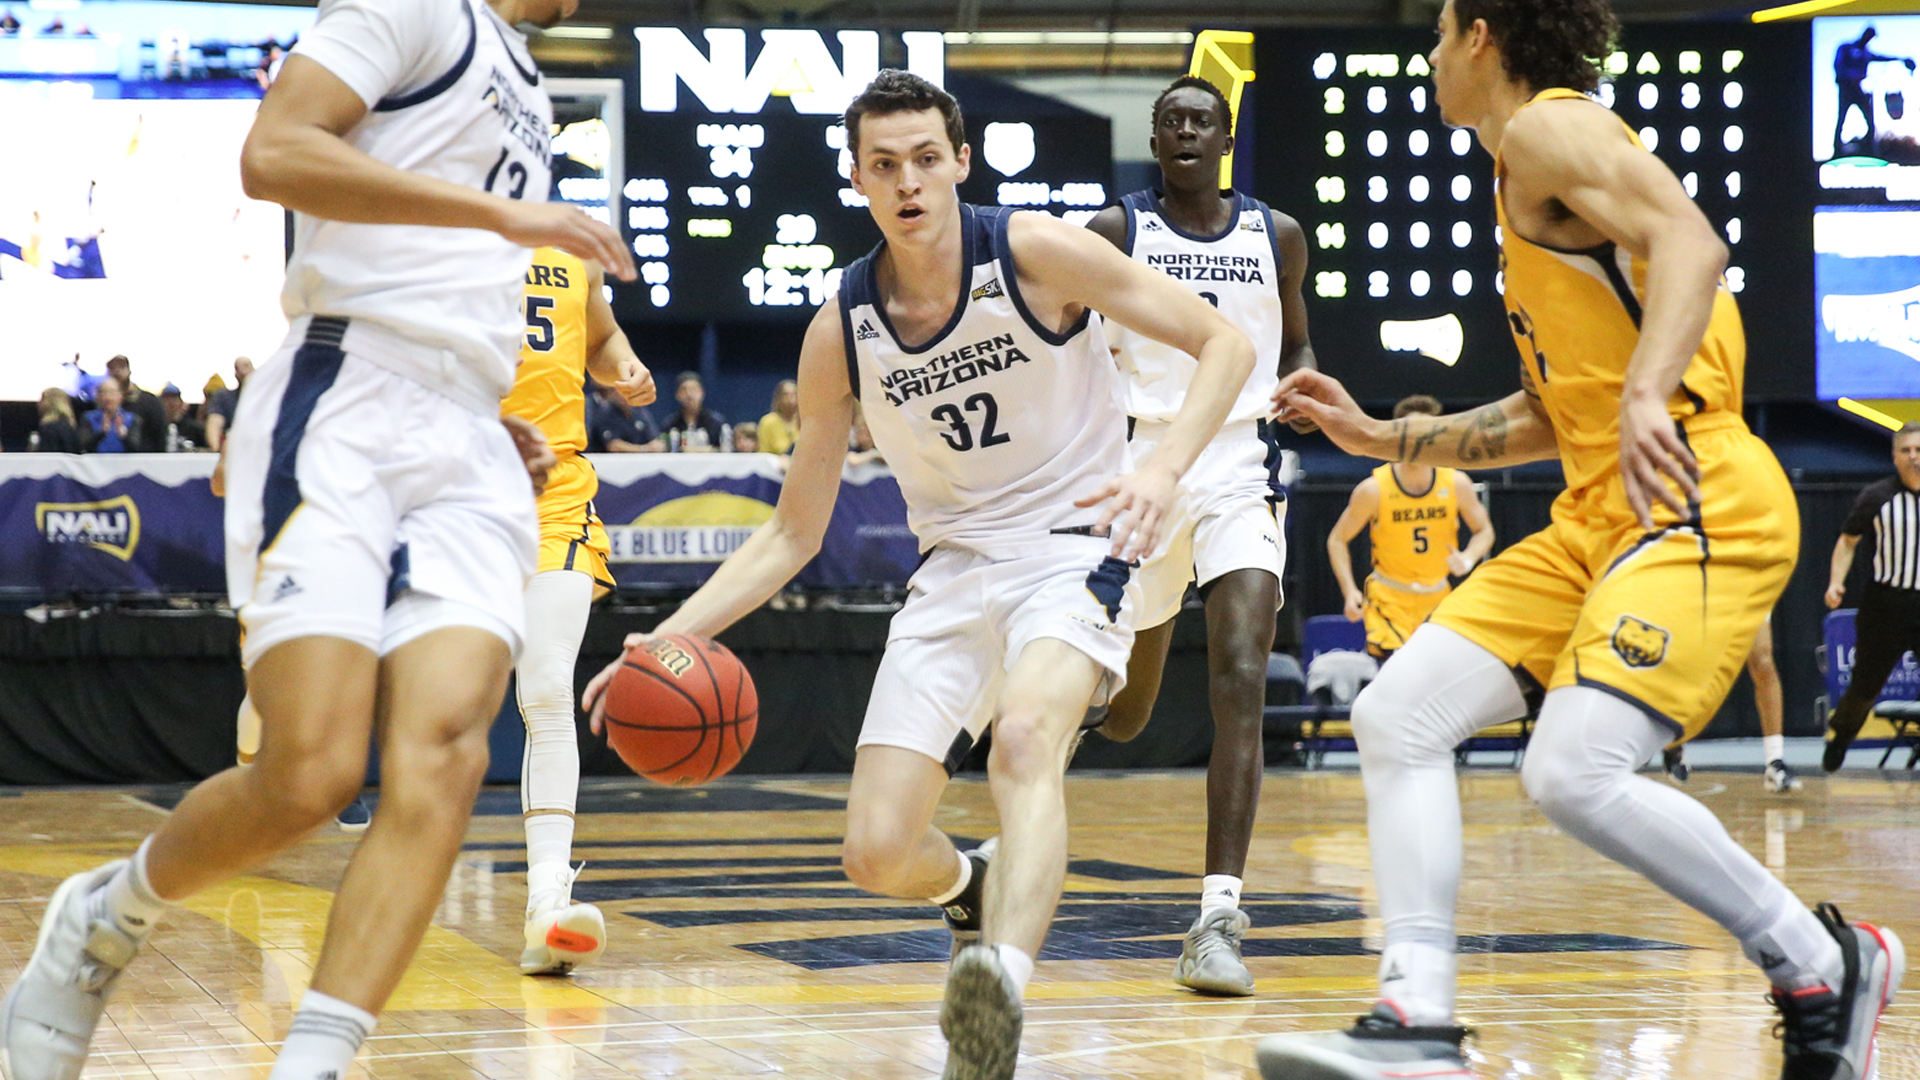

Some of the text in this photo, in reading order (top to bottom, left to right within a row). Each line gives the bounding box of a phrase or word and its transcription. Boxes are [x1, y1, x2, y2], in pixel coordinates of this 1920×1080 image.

[633, 27, 945, 114] NAU
[1636, 52, 1660, 74] A
[1410, 86, 1426, 113] 1
[1367, 130, 1388, 157] 0
[1409, 129, 1429, 156] 0
[735, 184, 751, 208] 1
[1409, 175, 1430, 202] 0
[1451, 174, 1472, 201] 0
[1725, 171, 1741, 198] 1
[1368, 222, 1389, 249] 0
[1410, 221, 1431, 248] 0
[1452, 221, 1473, 248] 0
[1725, 217, 1741, 244] 1
[1147, 253, 1260, 269] NORTHERN
[1153, 266, 1265, 286] RIZONA
[1410, 270, 1431, 297] 0
[1452, 269, 1473, 296] 0
[526, 295, 555, 352] 5
[878, 332, 986, 389] NORTHERN
[885, 347, 1032, 408] ARIZONA
[930, 391, 1012, 453] 32
[46, 511, 128, 536] NAU
[1392, 506, 1448, 522] BEARS
[632, 531, 690, 557] BLUE
[1413, 526, 1429, 554] 5
